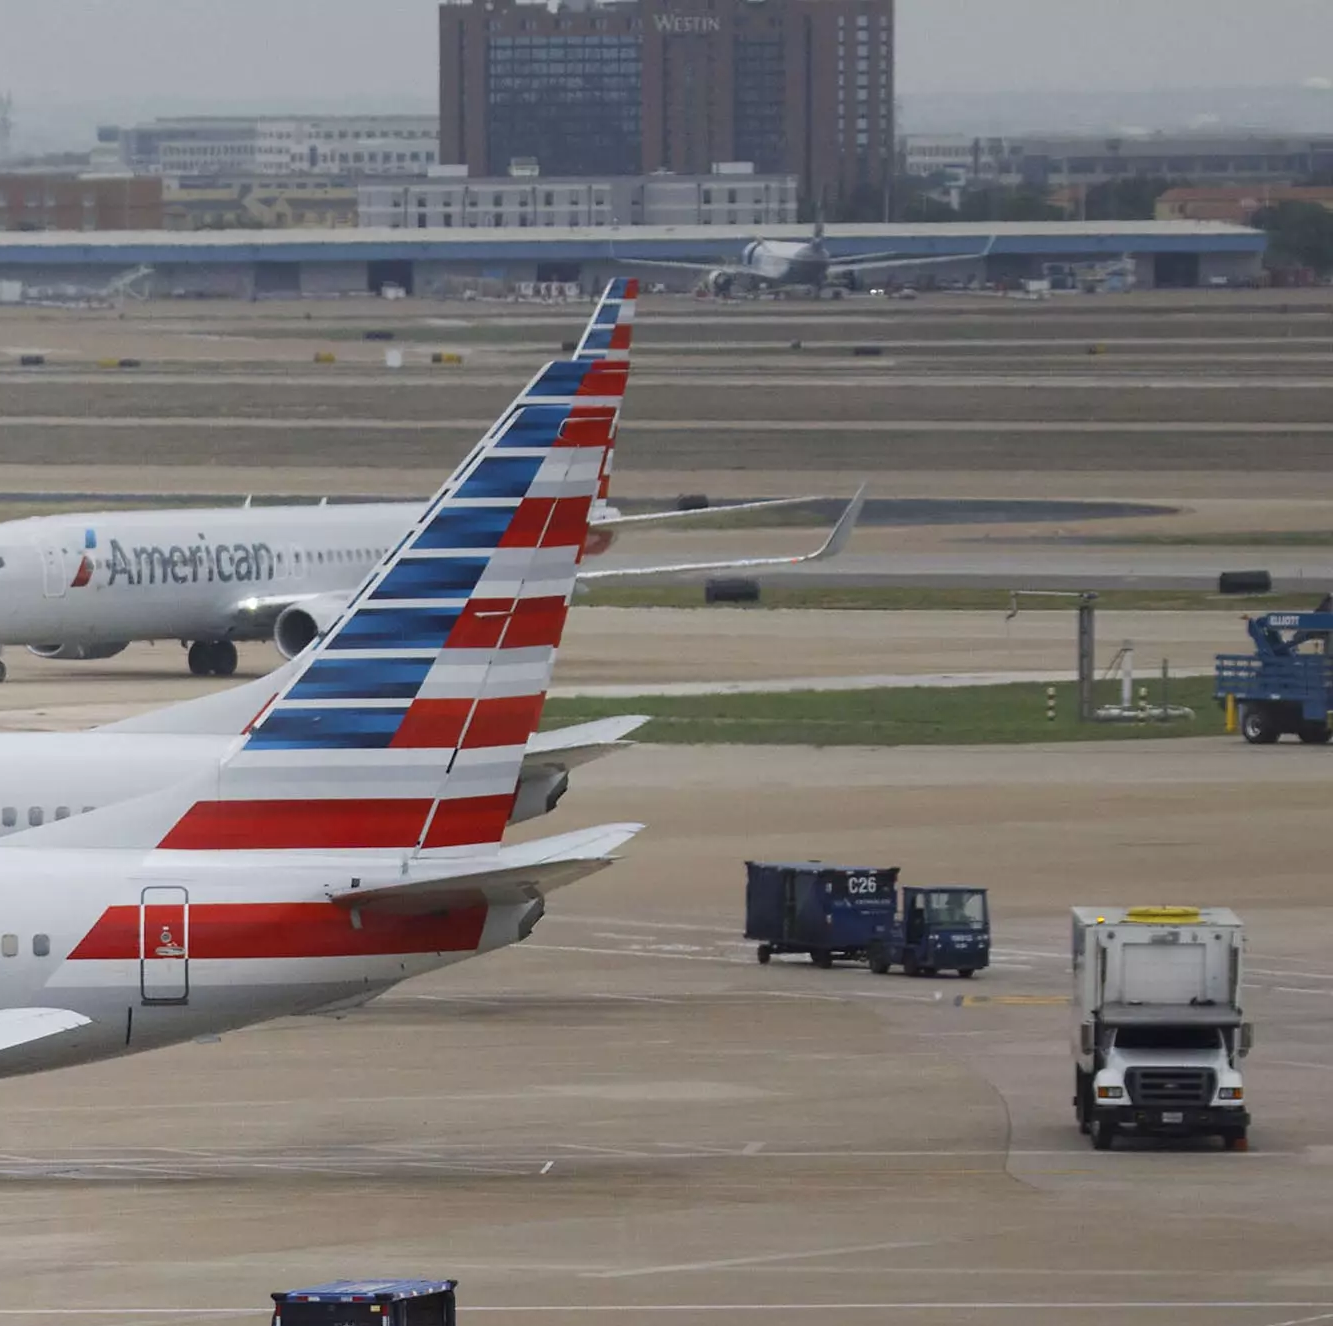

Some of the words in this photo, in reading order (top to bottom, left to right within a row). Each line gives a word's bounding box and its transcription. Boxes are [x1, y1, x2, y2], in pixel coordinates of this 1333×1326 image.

[107, 532, 274, 586] American
[1269, 615, 1300, 626] ELLIOTT
[848, 876, 877, 894] C26
